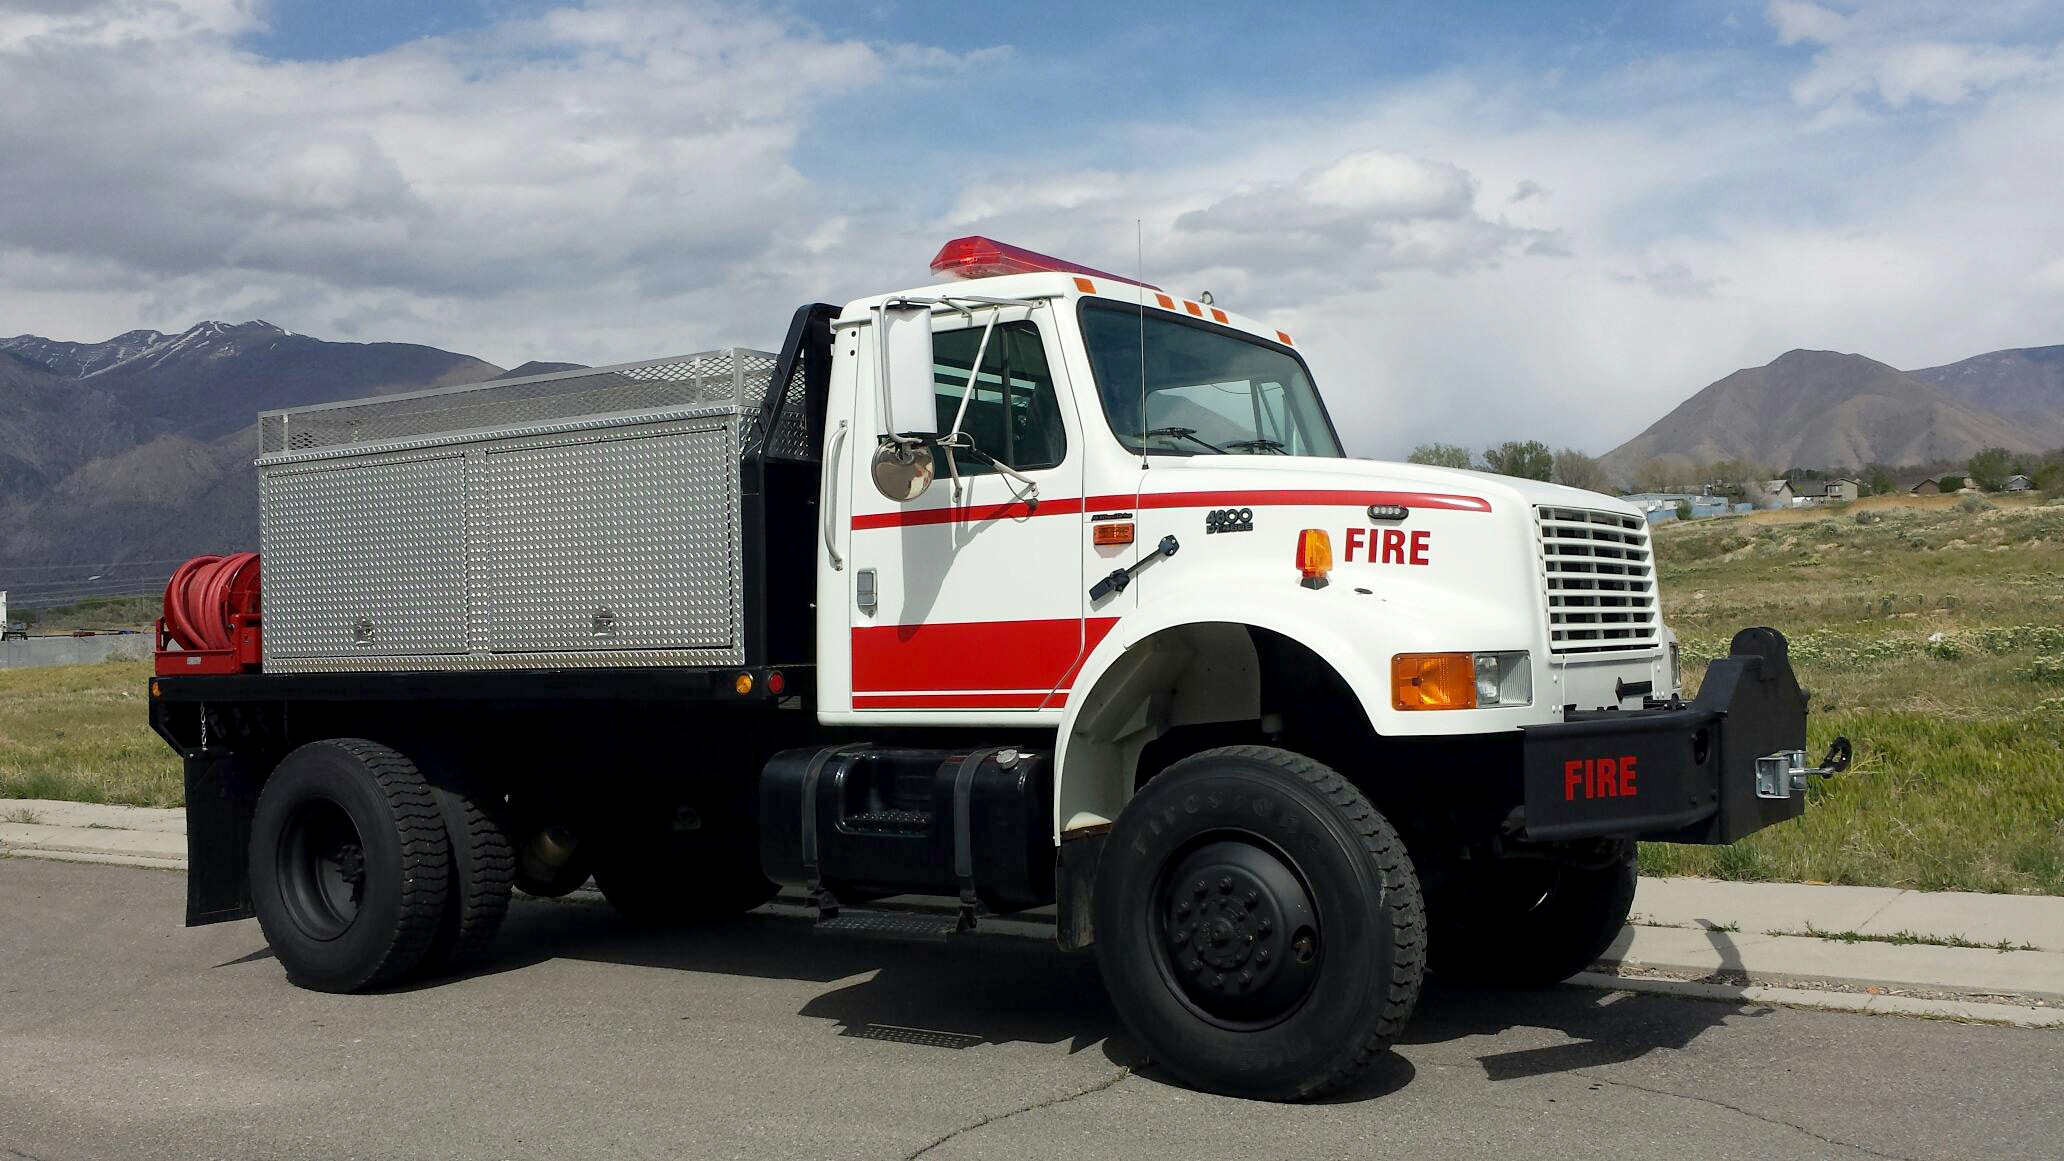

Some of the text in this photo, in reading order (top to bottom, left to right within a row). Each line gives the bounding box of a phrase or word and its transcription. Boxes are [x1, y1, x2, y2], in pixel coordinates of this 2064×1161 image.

[1206, 508, 1252, 526] 4800
[1344, 527, 1431, 566] FIRE
[1564, 756, 1638, 801] FIRE
